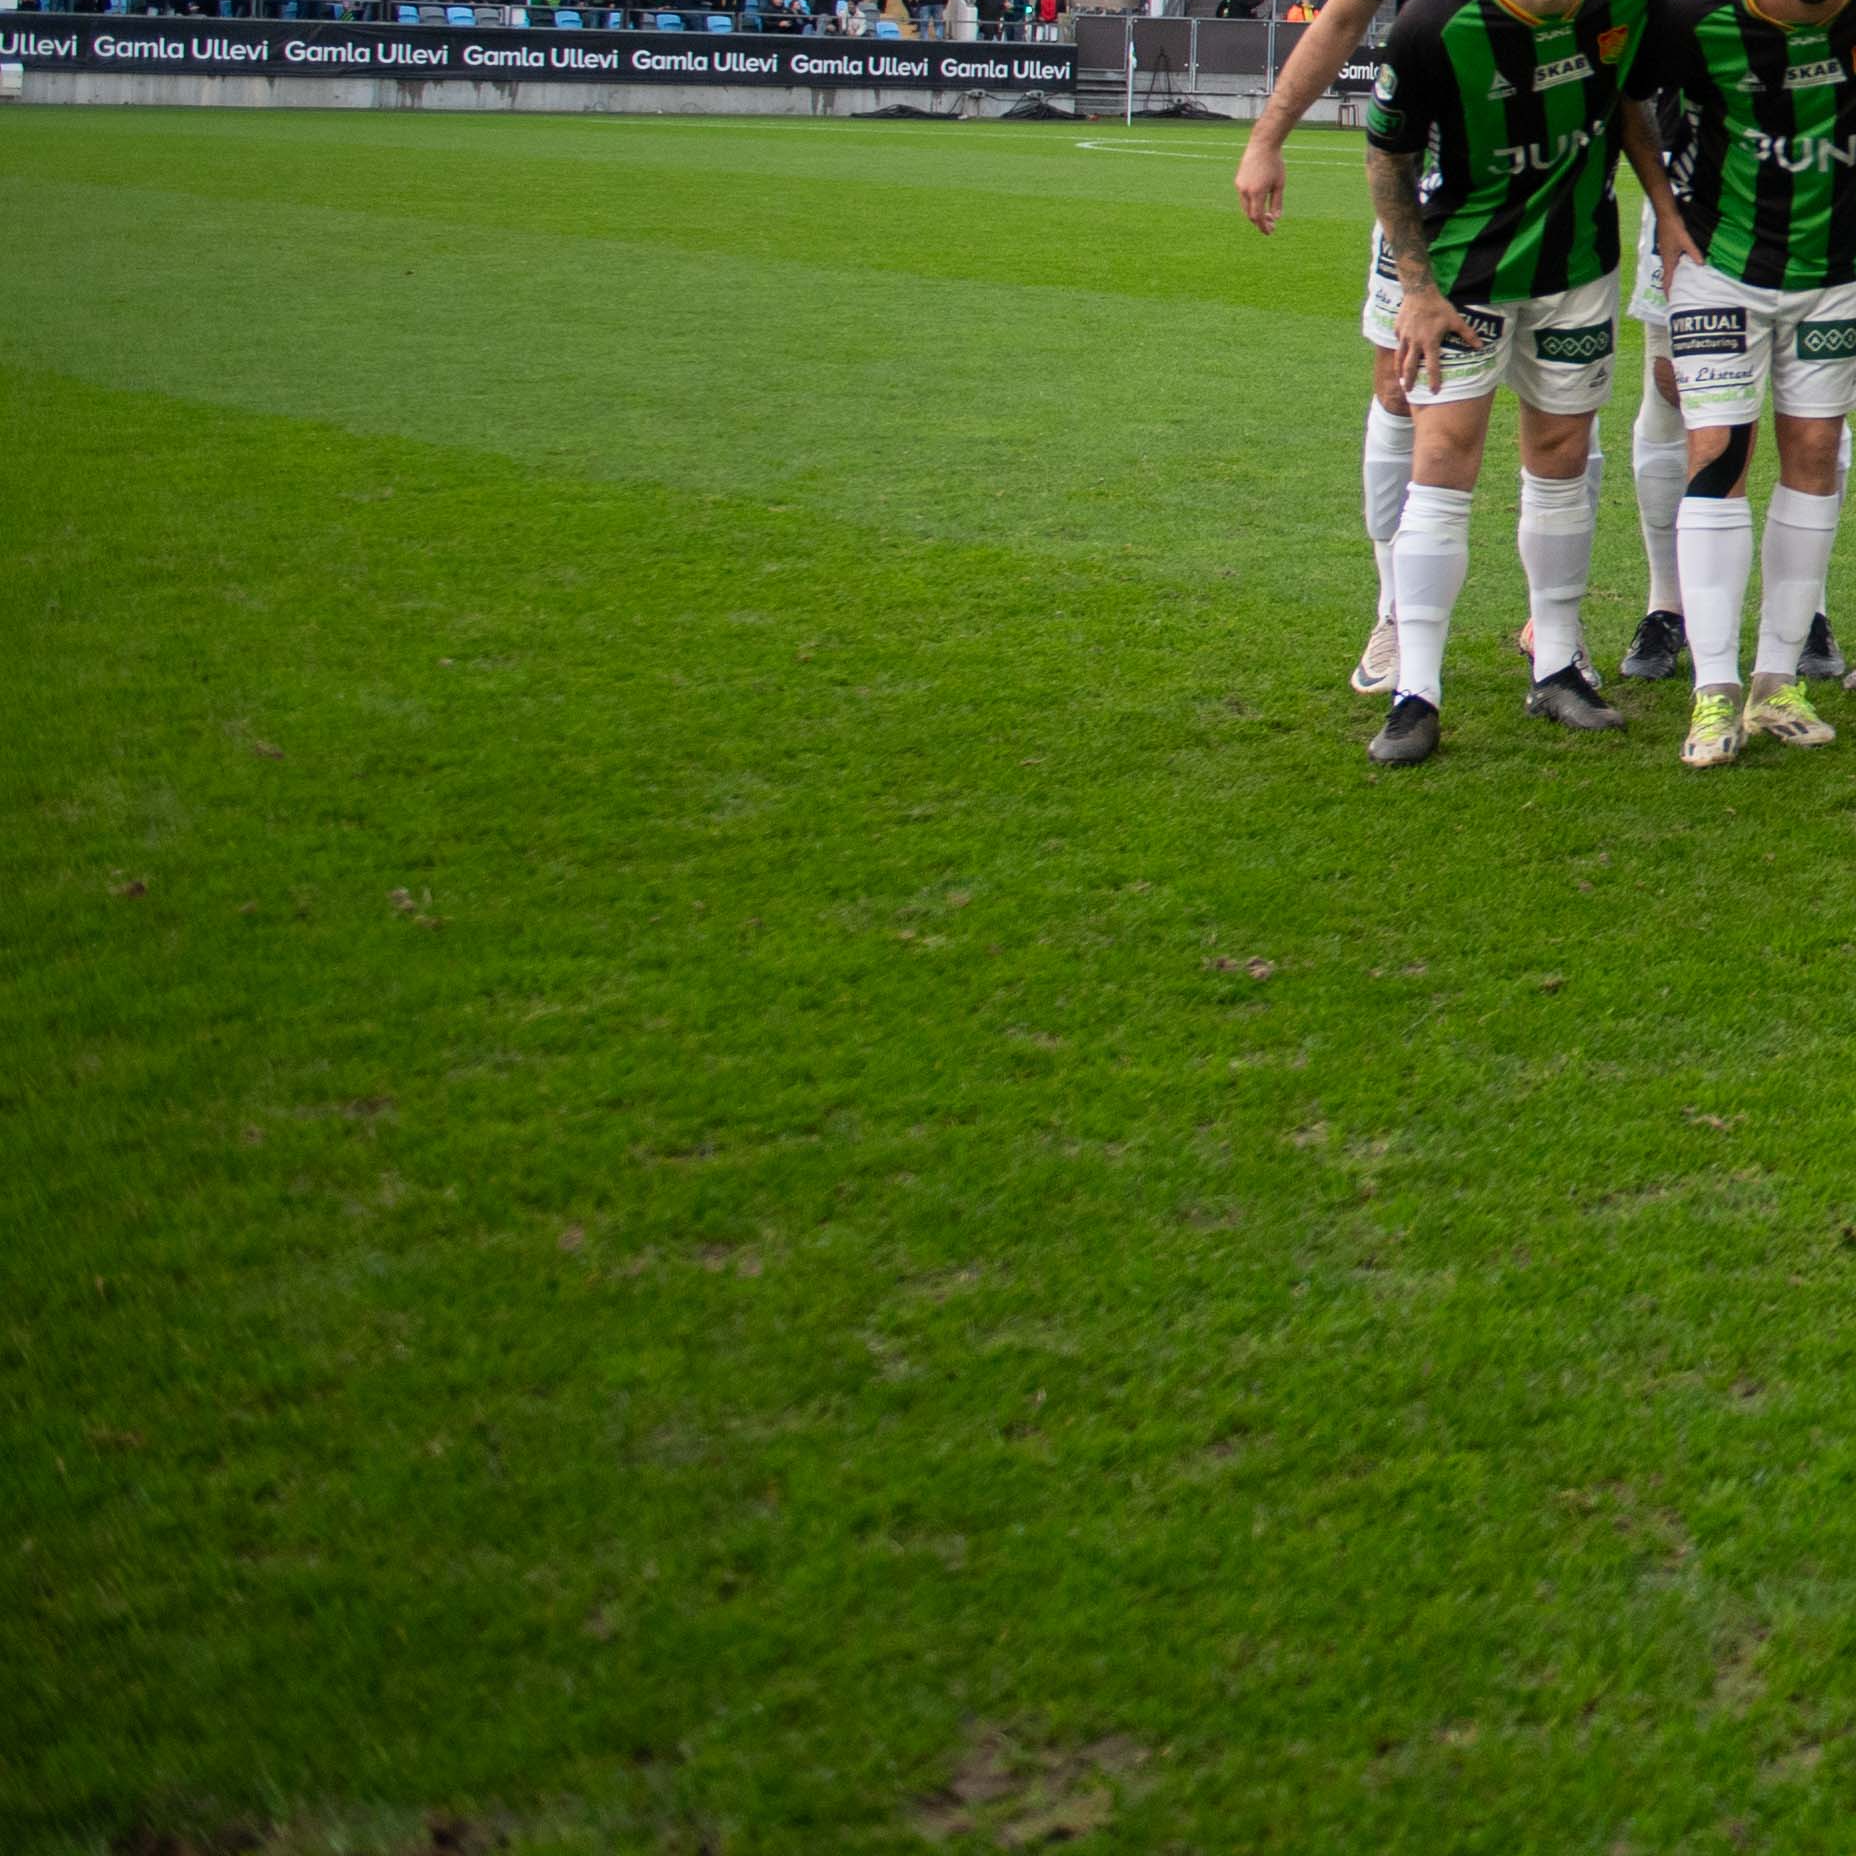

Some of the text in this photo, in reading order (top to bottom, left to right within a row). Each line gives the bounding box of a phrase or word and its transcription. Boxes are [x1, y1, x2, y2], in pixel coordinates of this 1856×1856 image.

[93, 35, 269, 62] Gamla Ullevi
[285, 40, 449, 66] Gamla Ullevi
[463, 44, 619, 70] Gamla Ullevi
[632, 49, 778, 74] Gamla Ullevi
[790, 53, 929, 77] Gamla Ullevi
[941, 57, 1071, 80] Gamla Ullevi
[1537, 55, 1587, 81] SKAB
[1786, 61, 1839, 80] SKAB
[1671, 312, 1741, 333] VIRTUAL
